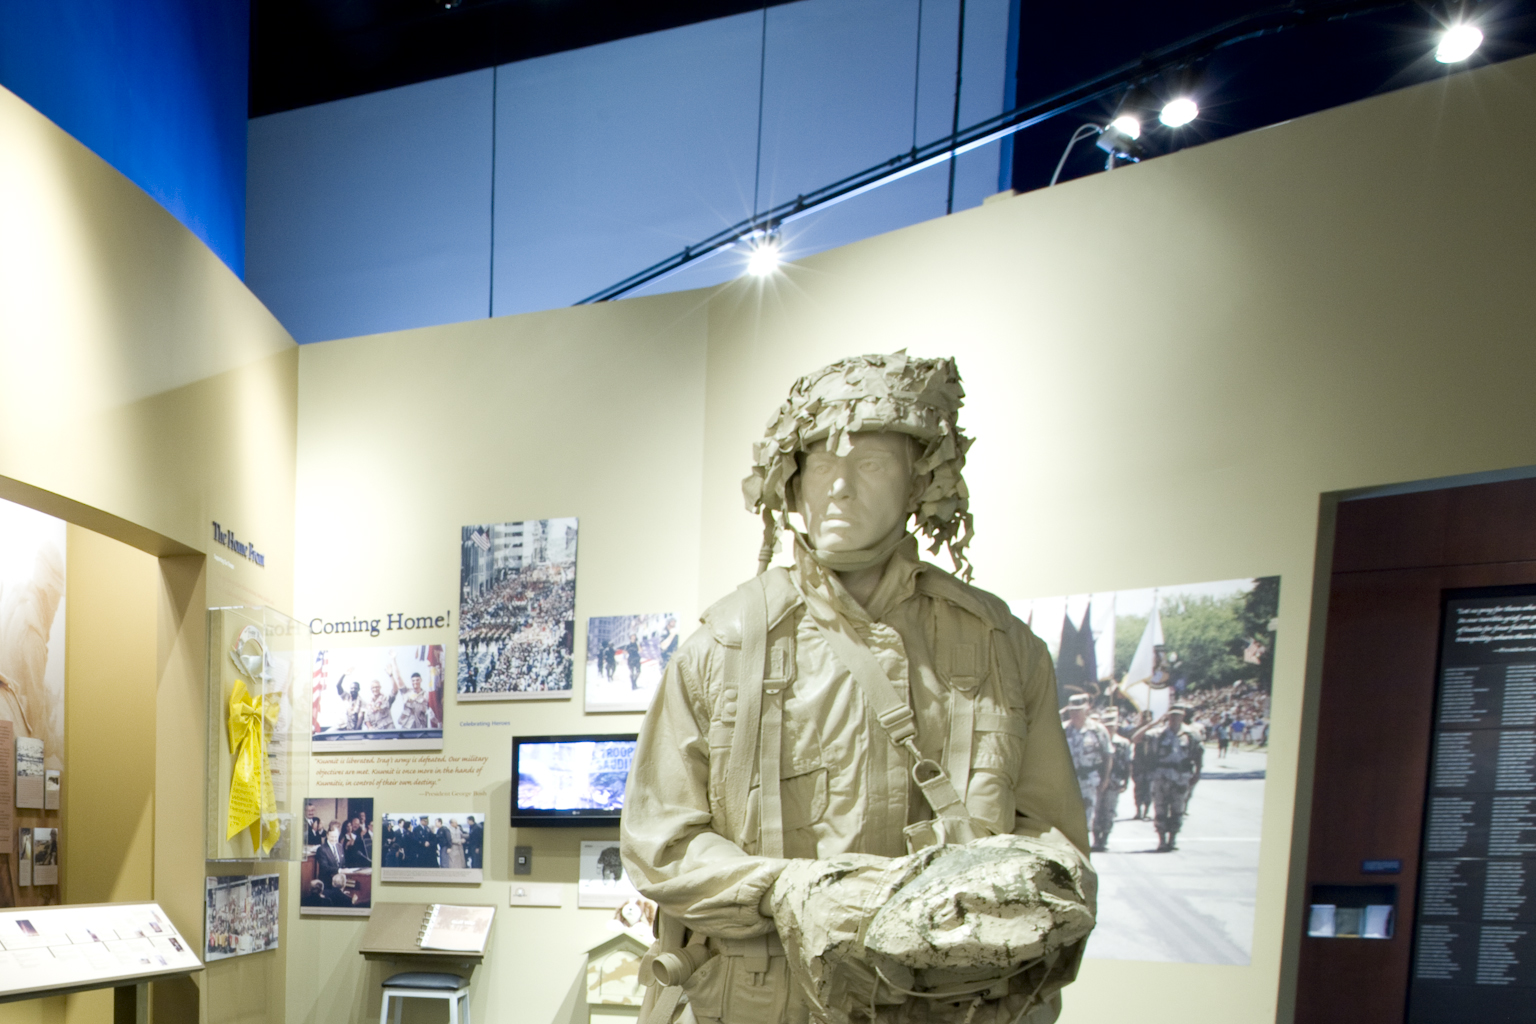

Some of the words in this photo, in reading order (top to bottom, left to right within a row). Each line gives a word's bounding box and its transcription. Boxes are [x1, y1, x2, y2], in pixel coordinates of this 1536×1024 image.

[212, 520, 227, 546] The
[309, 615, 381, 637] Coming
[386, 610, 451, 631] Home!
[394, 757, 411, 767] army
[461, 755, 489, 766] military
[443, 766, 454, 774] the
[455, 766, 475, 774] hands
[353, 779, 375, 787] control
[382, 778, 398, 786] their
